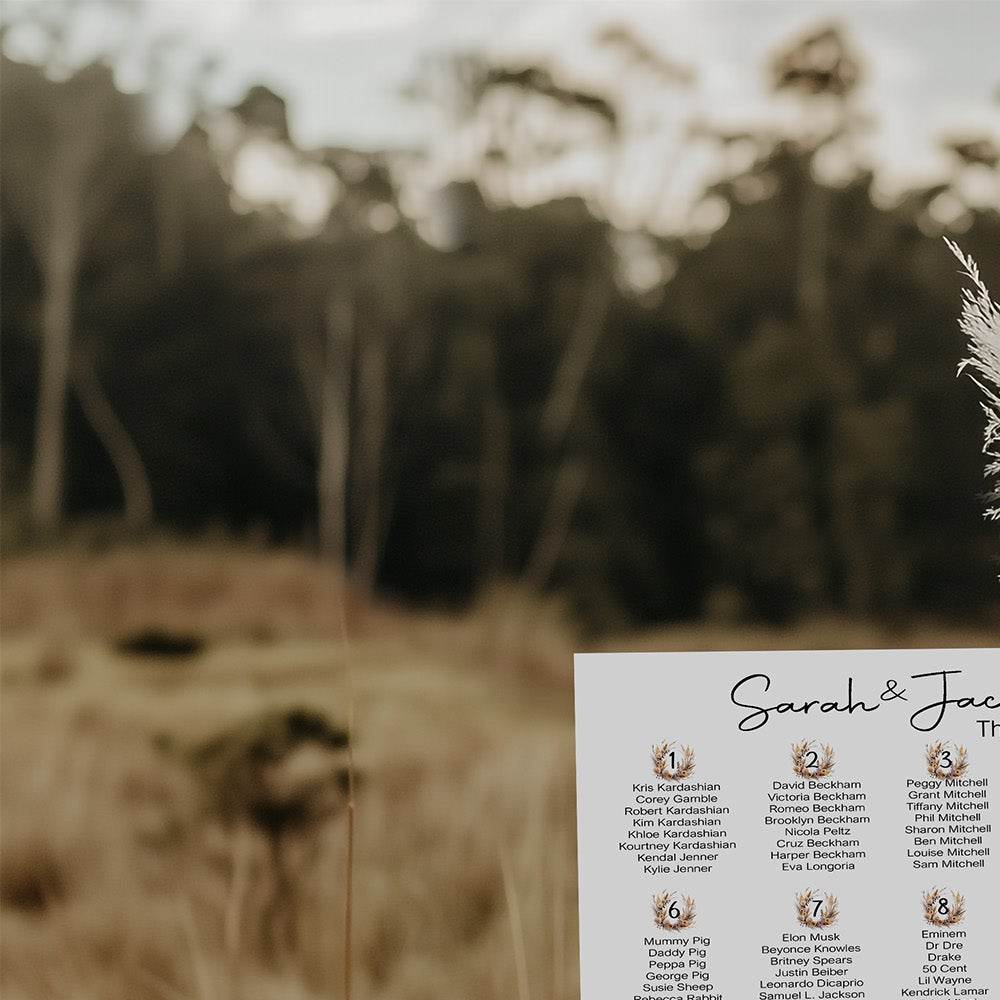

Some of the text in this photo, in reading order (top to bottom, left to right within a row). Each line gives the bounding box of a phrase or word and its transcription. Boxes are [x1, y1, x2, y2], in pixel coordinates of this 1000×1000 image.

[730, 673, 880, 732] Sarah
[880, 679, 908, 701] &
[668, 751, 678, 769] 1
[805, 751, 819, 769] 2
[939, 751, 952, 769] 3
[632, 782, 721, 793] Kris Kardashian
[772, 780, 862, 791] David Beckham
[906, 777, 989, 789] Peggy Mitchell
[635, 793, 718, 806] Corey Gamble
[767, 791, 867, 802] Victoria Beckham
[908, 789, 987, 800] Grant Mitchell
[624, 805, 730, 816] Robert Kardashian
[769, 803, 866, 814] Romeo Beckham
[905, 801, 989, 813] Tiffany Mitchell
[632, 817, 722, 827] Kim Kardashian
[764, 815, 871, 827] Brooklyn Beckham
[914, 812, 981, 823] Phil Mitchell
[627, 828, 727, 839] Khloe Kardashian
[784, 826, 851, 837] Nicola Peltz
[904, 824, 992, 835] Sharon Mitchell
[668, 900, 681, 919] 6
[811, 900, 824, 918] 7
[937, 897, 949, 916] 8
[782, 932, 841, 943] Elon Musk
[921, 929, 967, 939] Eminem
[643, 936, 711, 948] Mummy Pig
[925, 940, 964, 951] Dr Dre
[648, 947, 707, 959] Daddy Pig
[761, 944, 862, 956] Beyonce Knowles
[770, 955, 853, 968] Britney Spears
[927, 952, 962, 962] Drake
[648, 959, 707, 971] Peppa Pig
[922, 963, 968, 974] 50 Cent
[645, 970, 710, 982] George Pig
[774, 967, 849, 978] Justin Beiber
[759, 978, 865, 989] Leonardo Dicaprio
[918, 975, 972, 987] Lil Wayne
[642, 982, 714, 993] Susie Sheep
